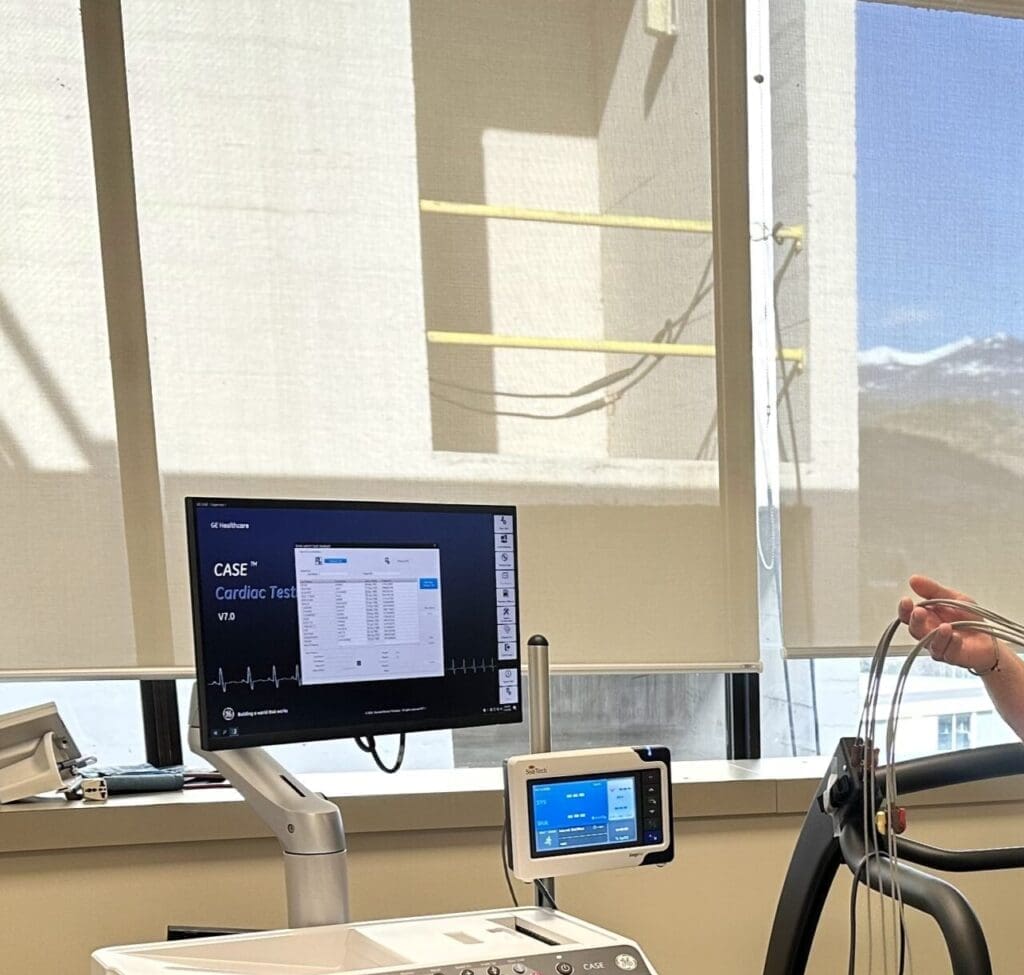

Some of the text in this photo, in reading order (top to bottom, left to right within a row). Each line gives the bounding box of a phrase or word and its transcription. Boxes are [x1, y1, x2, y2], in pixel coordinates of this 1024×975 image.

[214, 563, 248, 577] CASE
[215, 585, 298, 601] Cardiac Test
[218, 612, 236, 621] V7.0
[583, 962, 606, 971] CASE
